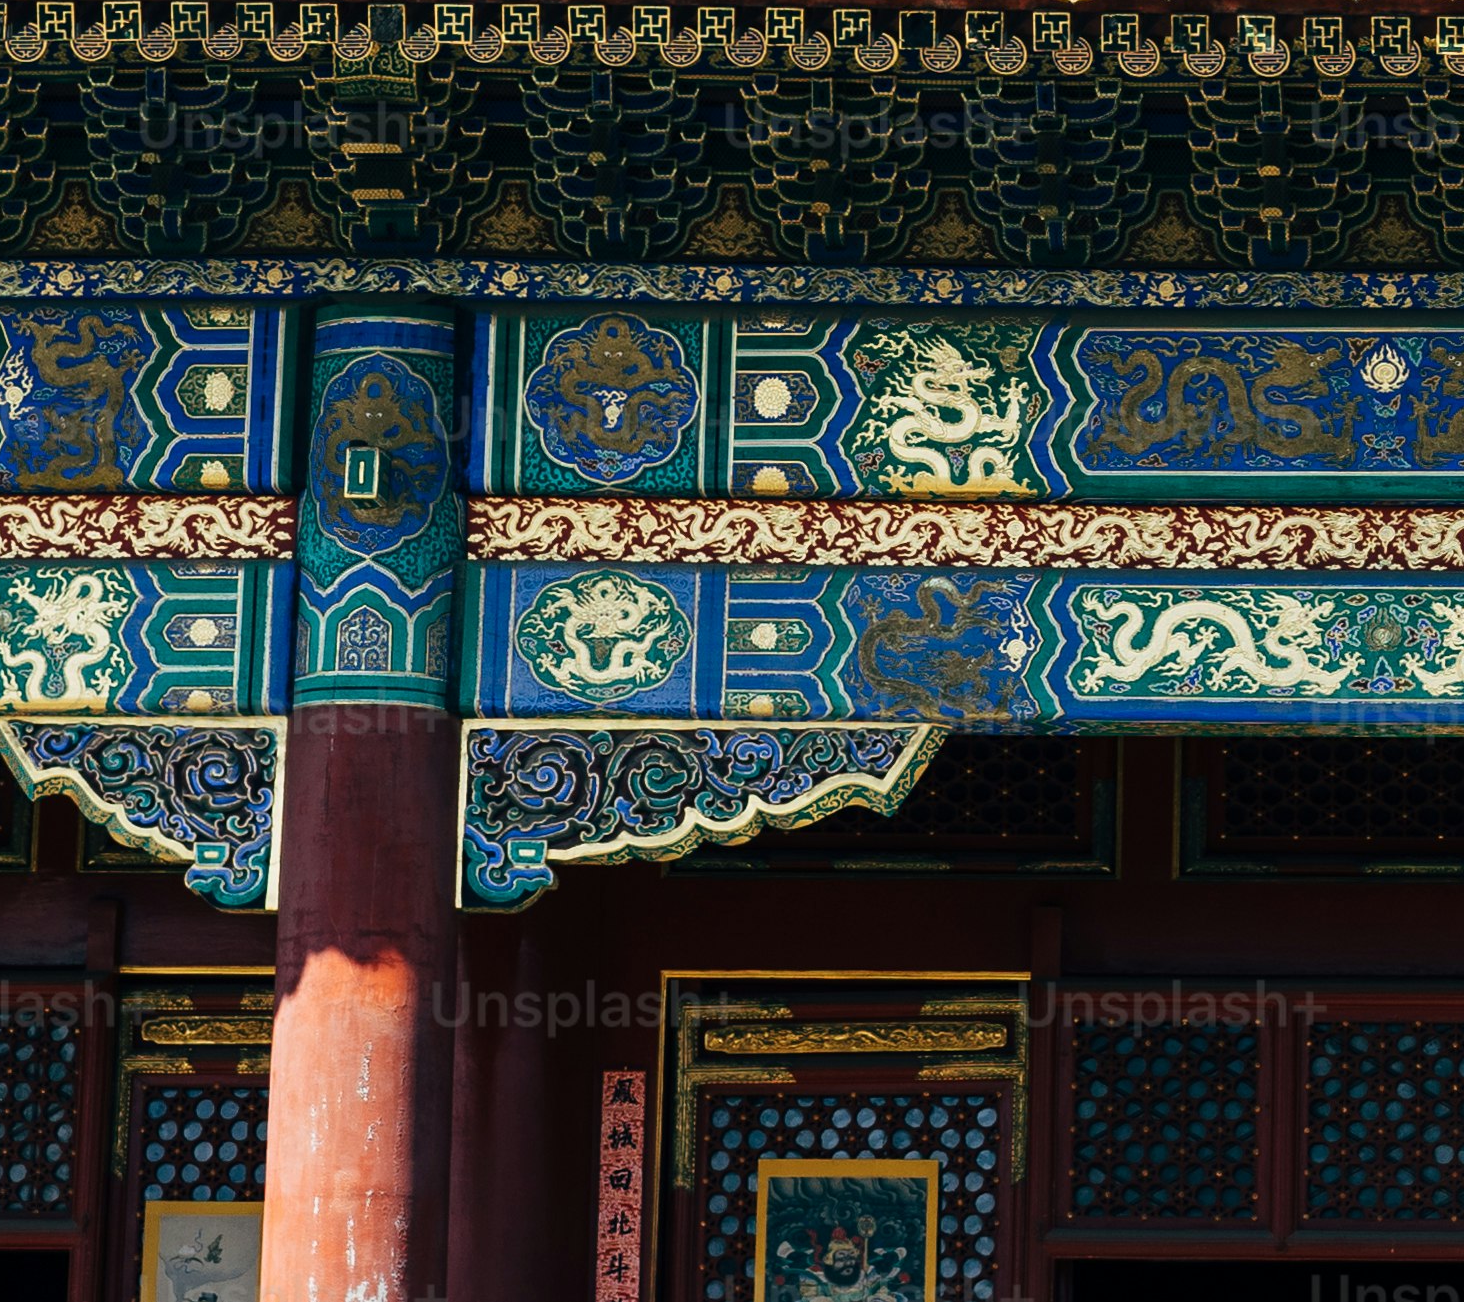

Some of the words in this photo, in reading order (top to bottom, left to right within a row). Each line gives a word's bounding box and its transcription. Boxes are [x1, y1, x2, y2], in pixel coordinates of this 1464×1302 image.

[604, 1078, 637, 1302] 鳳城回北斗
